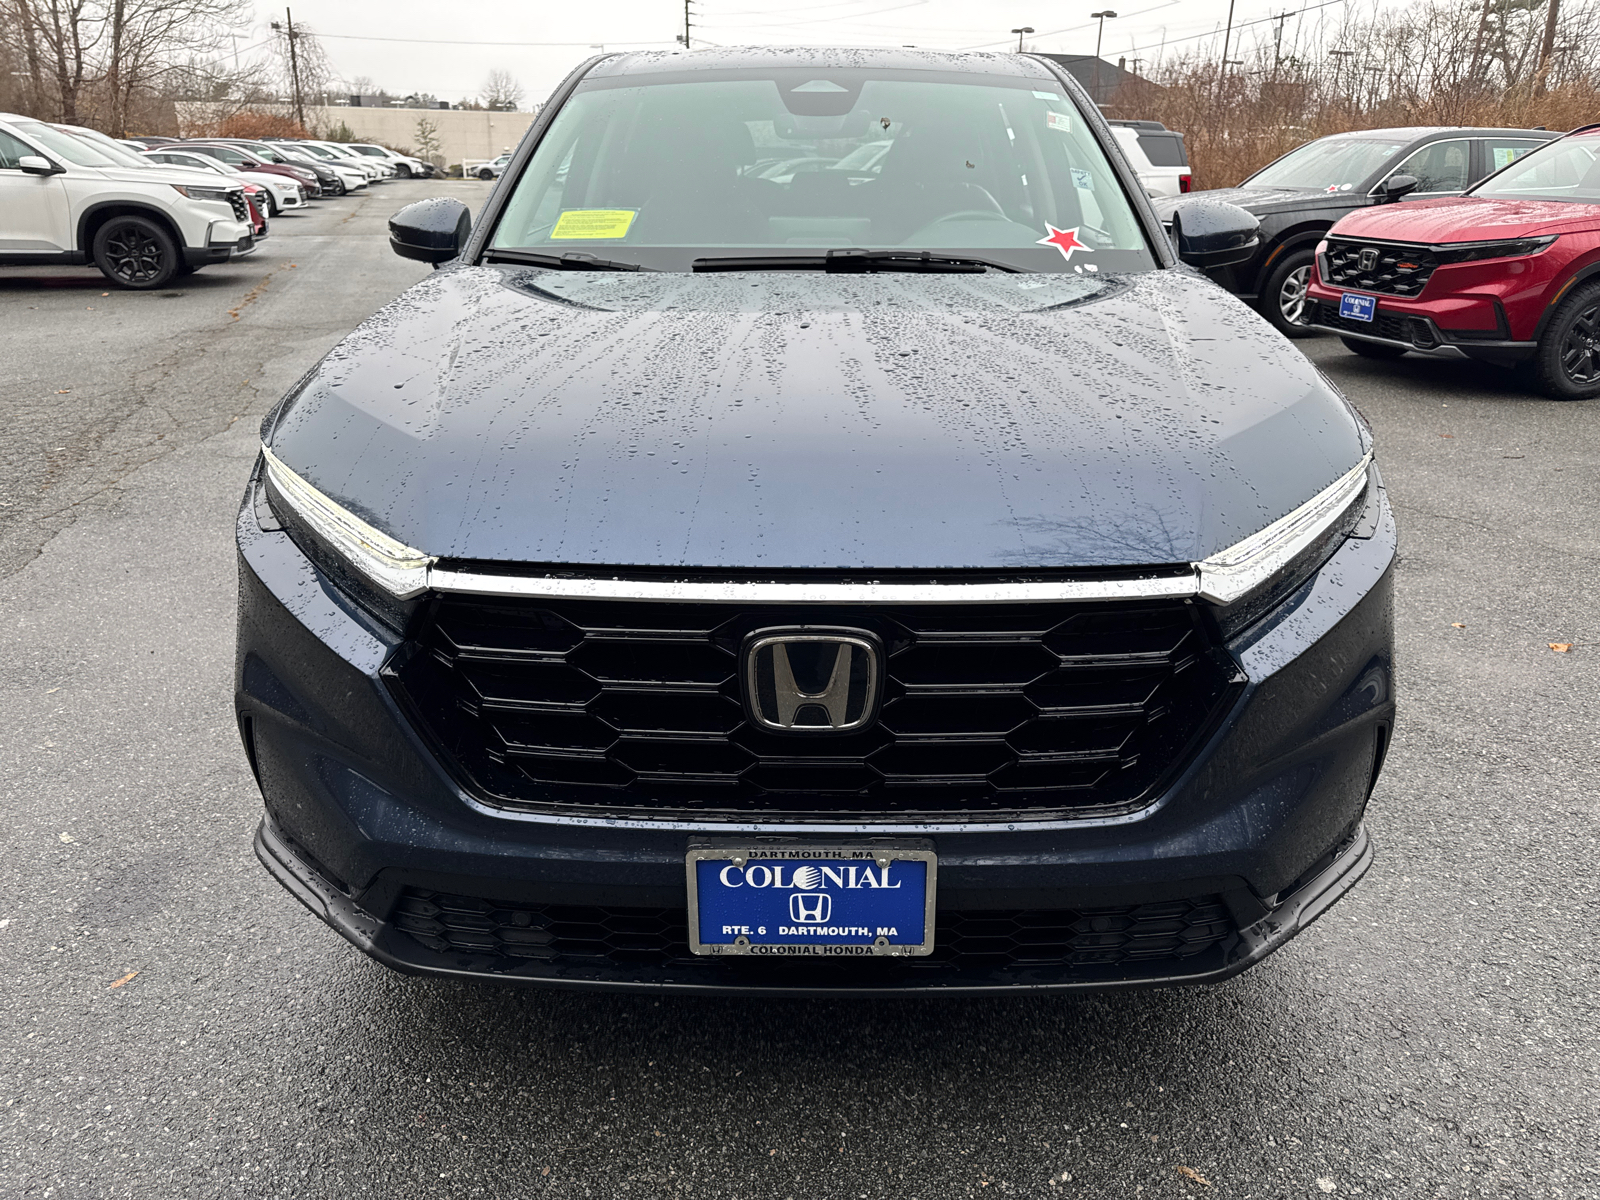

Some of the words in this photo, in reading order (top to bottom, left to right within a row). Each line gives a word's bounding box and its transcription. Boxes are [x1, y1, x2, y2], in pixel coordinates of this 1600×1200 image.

[719, 865, 902, 890] COLONIAL
[722, 925, 754, 935] RTE.
[758, 926, 767, 935] 6
[778, 926, 872, 937] DARTMOUTH,
[876, 926, 898, 936] MA
[750, 945, 820, 955] COLONIAL
[823, 946, 874, 955] HONDA
